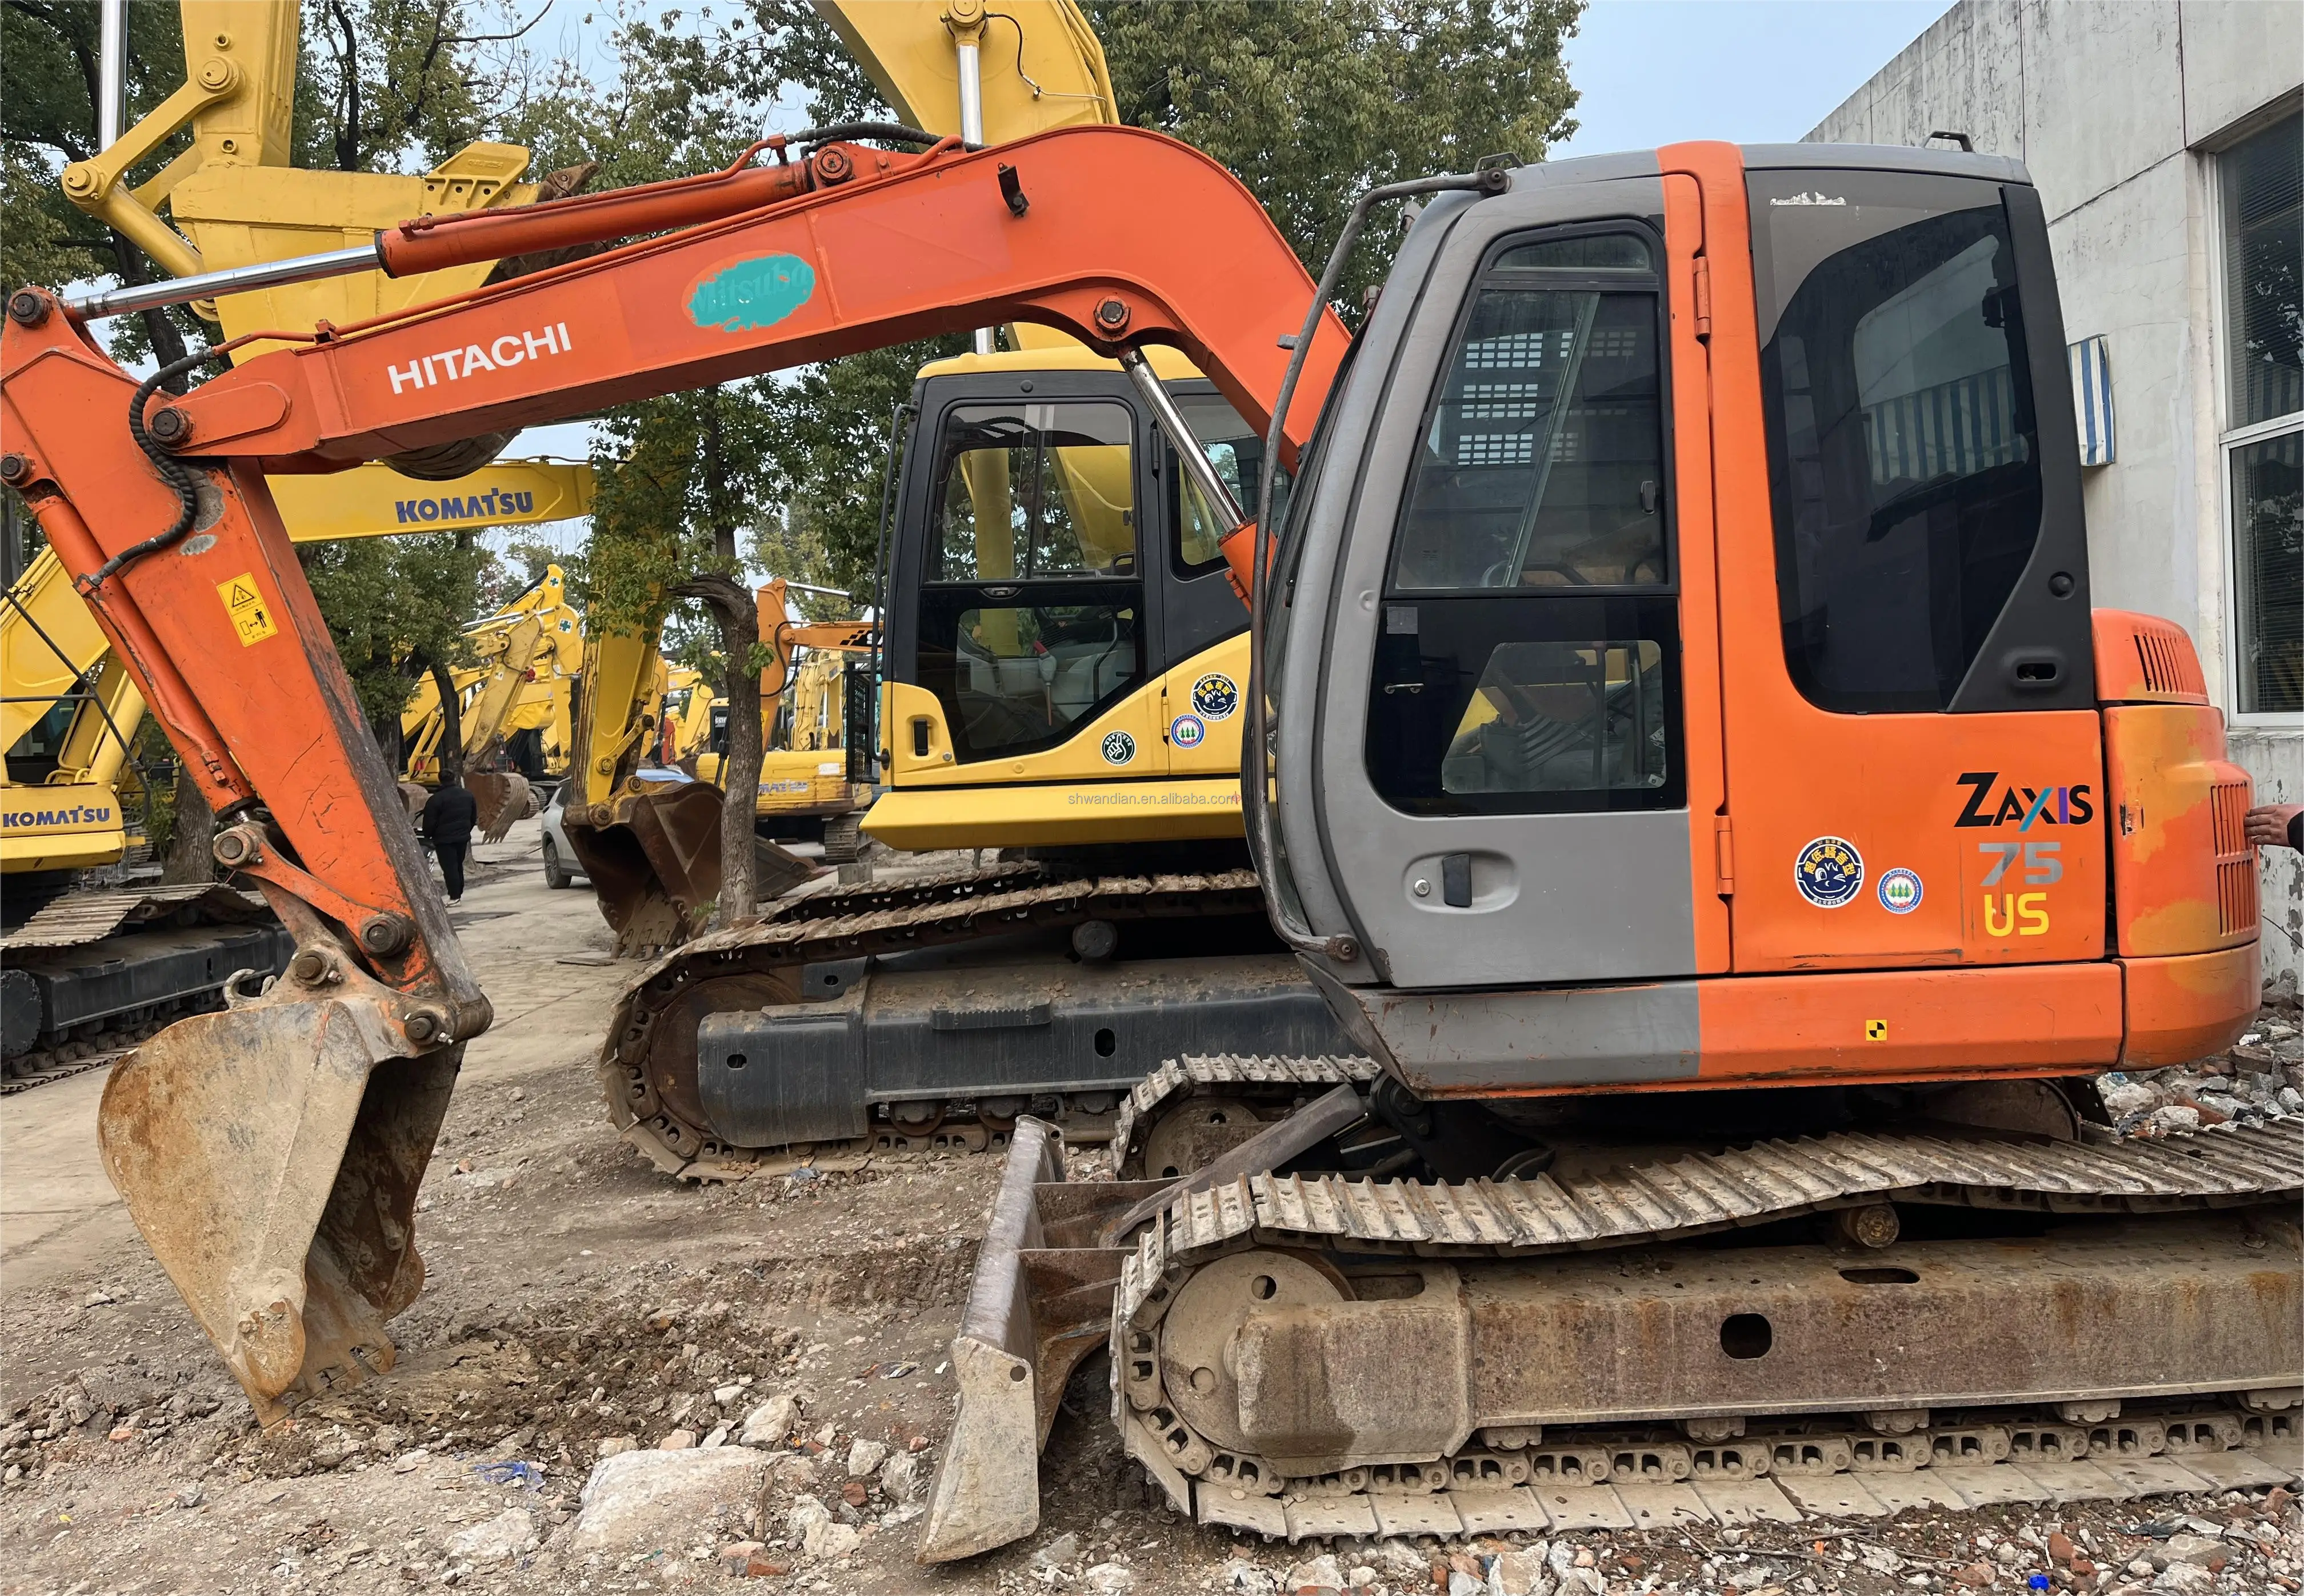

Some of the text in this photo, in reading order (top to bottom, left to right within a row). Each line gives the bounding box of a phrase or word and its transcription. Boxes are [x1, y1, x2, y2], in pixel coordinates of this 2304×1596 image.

[387, 322, 572, 395] HITACHI
[395, 487, 534, 523] KOMATSU
[3, 805, 110, 827] KOMATSU
[1953, 771, 2094, 832] ZAXIS
[1979, 841, 2063, 887] 75
[1983, 892, 2050, 937] US
